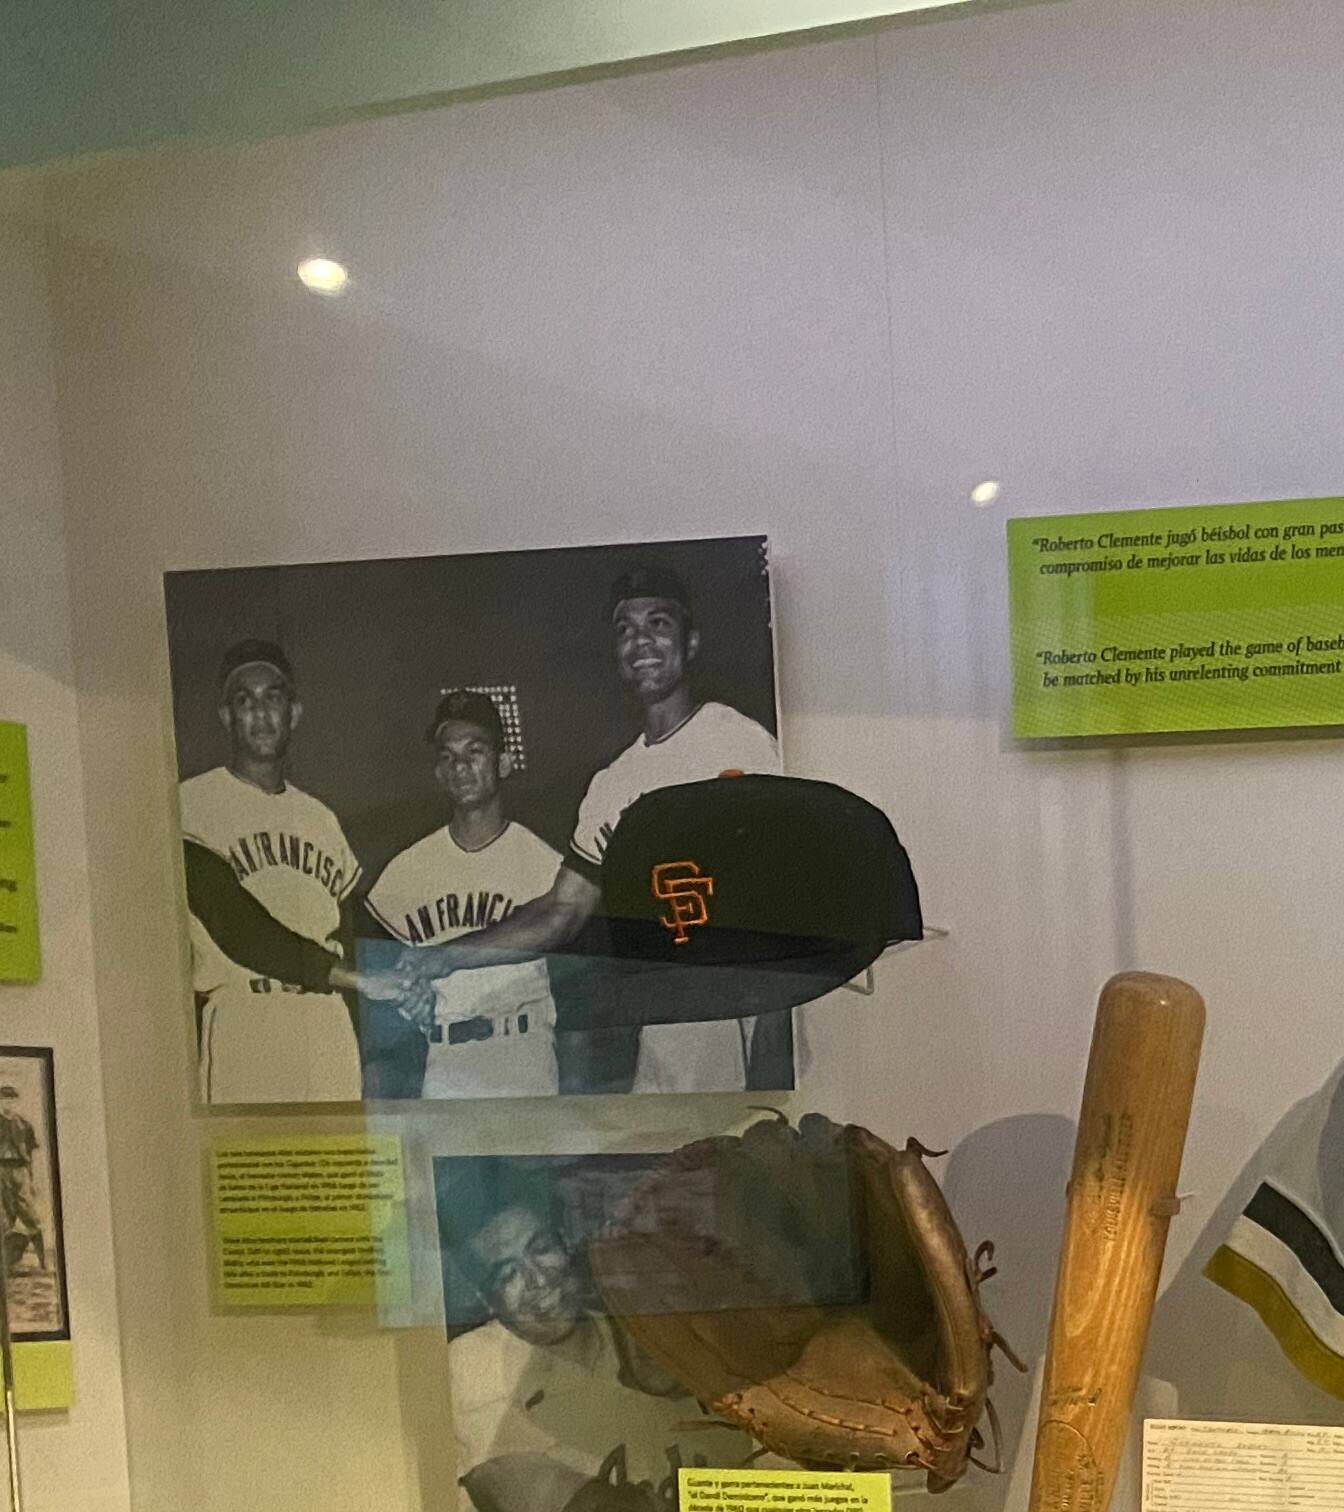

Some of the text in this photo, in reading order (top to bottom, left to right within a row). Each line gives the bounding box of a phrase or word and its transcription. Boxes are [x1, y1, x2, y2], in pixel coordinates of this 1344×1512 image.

[1096, 531, 1163, 549] Clemente
[1163, 527, 1197, 549] jugó
[1200, 523, 1251, 542] béisbol
[1253, 525, 1279, 540] con
[1281, 523, 1316, 541] gran
[1099, 645, 1167, 663] Clemente
[1168, 640, 1217, 663] played
[1218, 638, 1242, 657] the
[1243, 641, 1284, 659] game
[1285, 635, 1304, 657] of
[651, 860, 714, 944] SF
